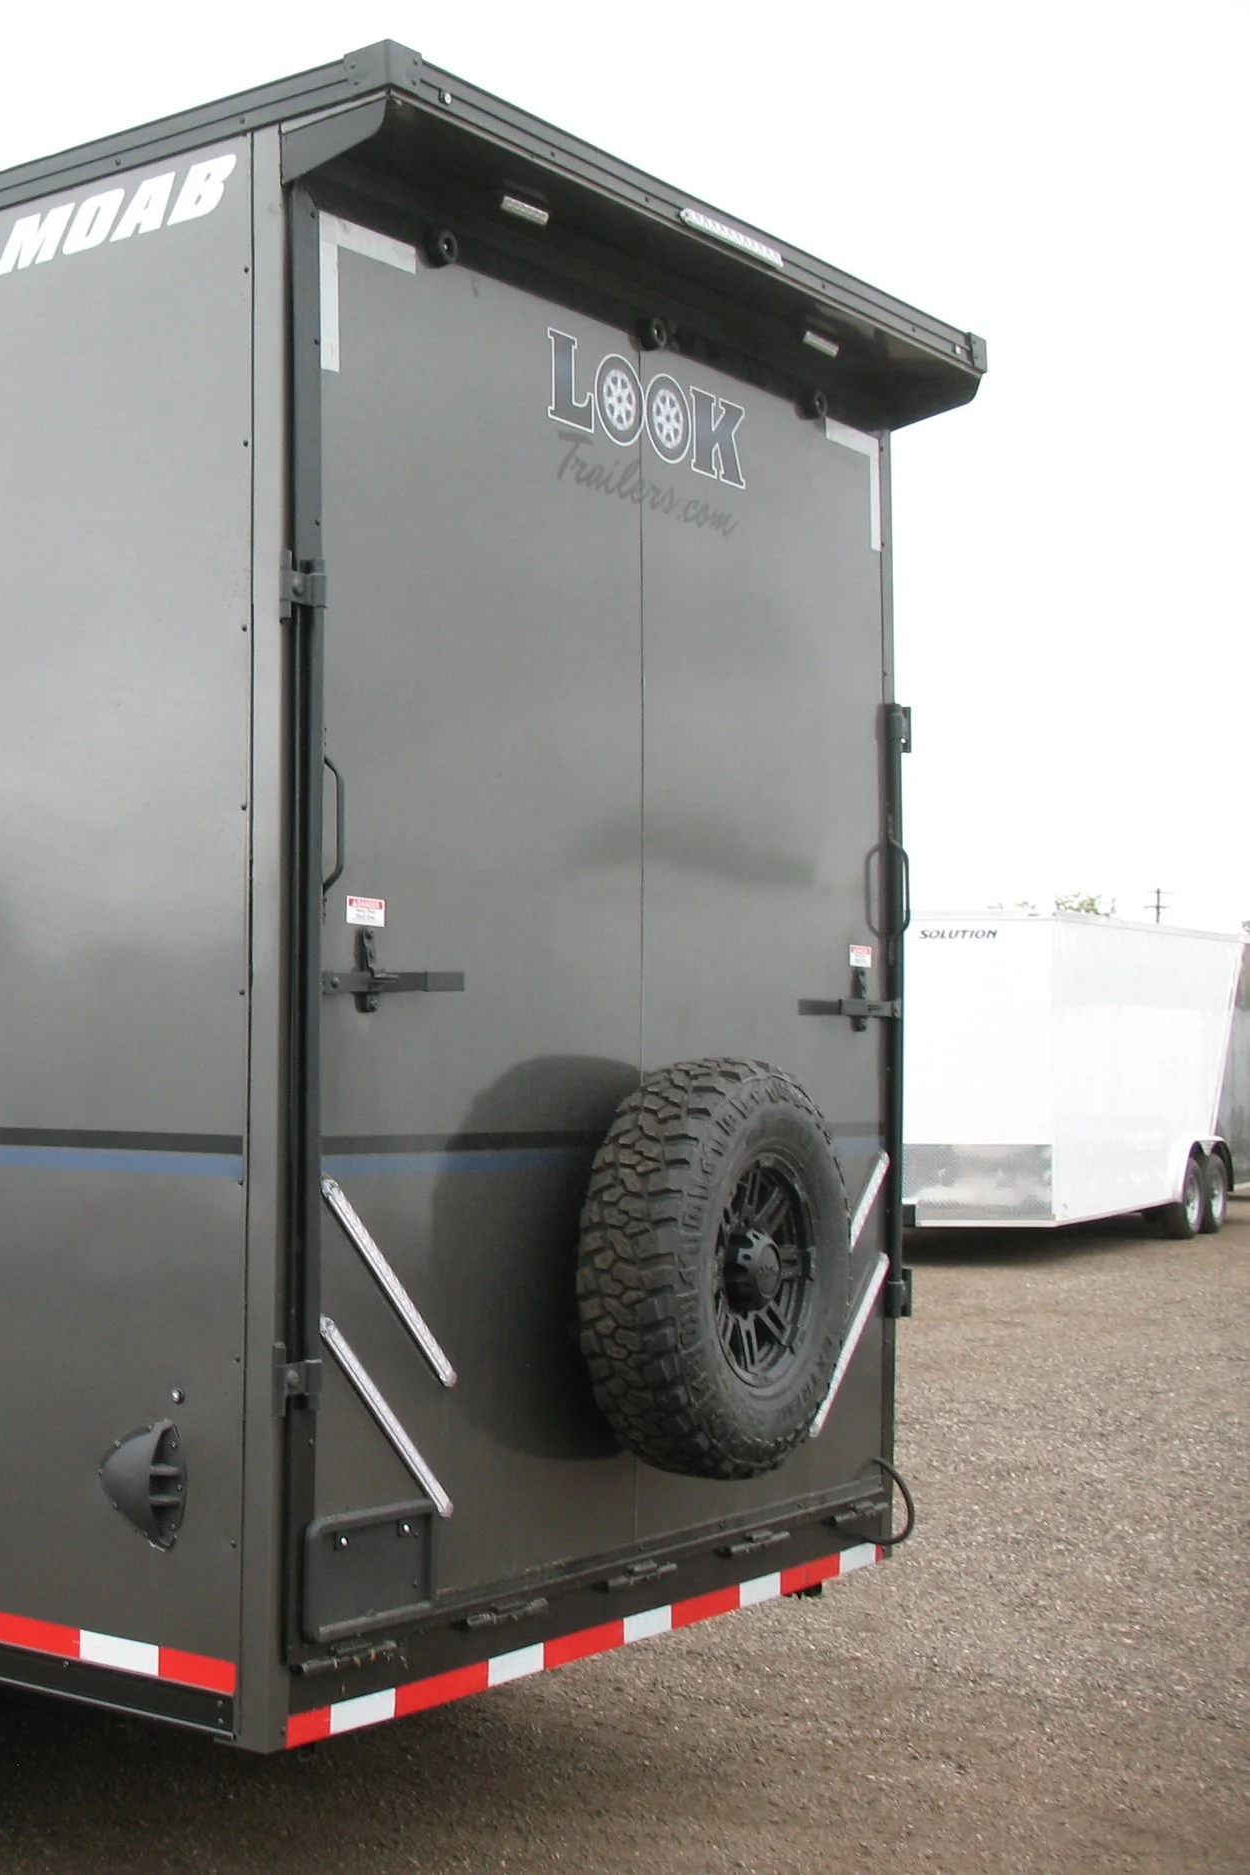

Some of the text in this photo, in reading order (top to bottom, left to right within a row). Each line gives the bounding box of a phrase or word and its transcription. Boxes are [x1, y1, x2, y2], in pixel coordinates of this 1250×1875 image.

[547, 326, 746, 489] LOOK
[557, 430, 739, 537] Trailers.com
[918, 929, 998, 939] SOLUTION
